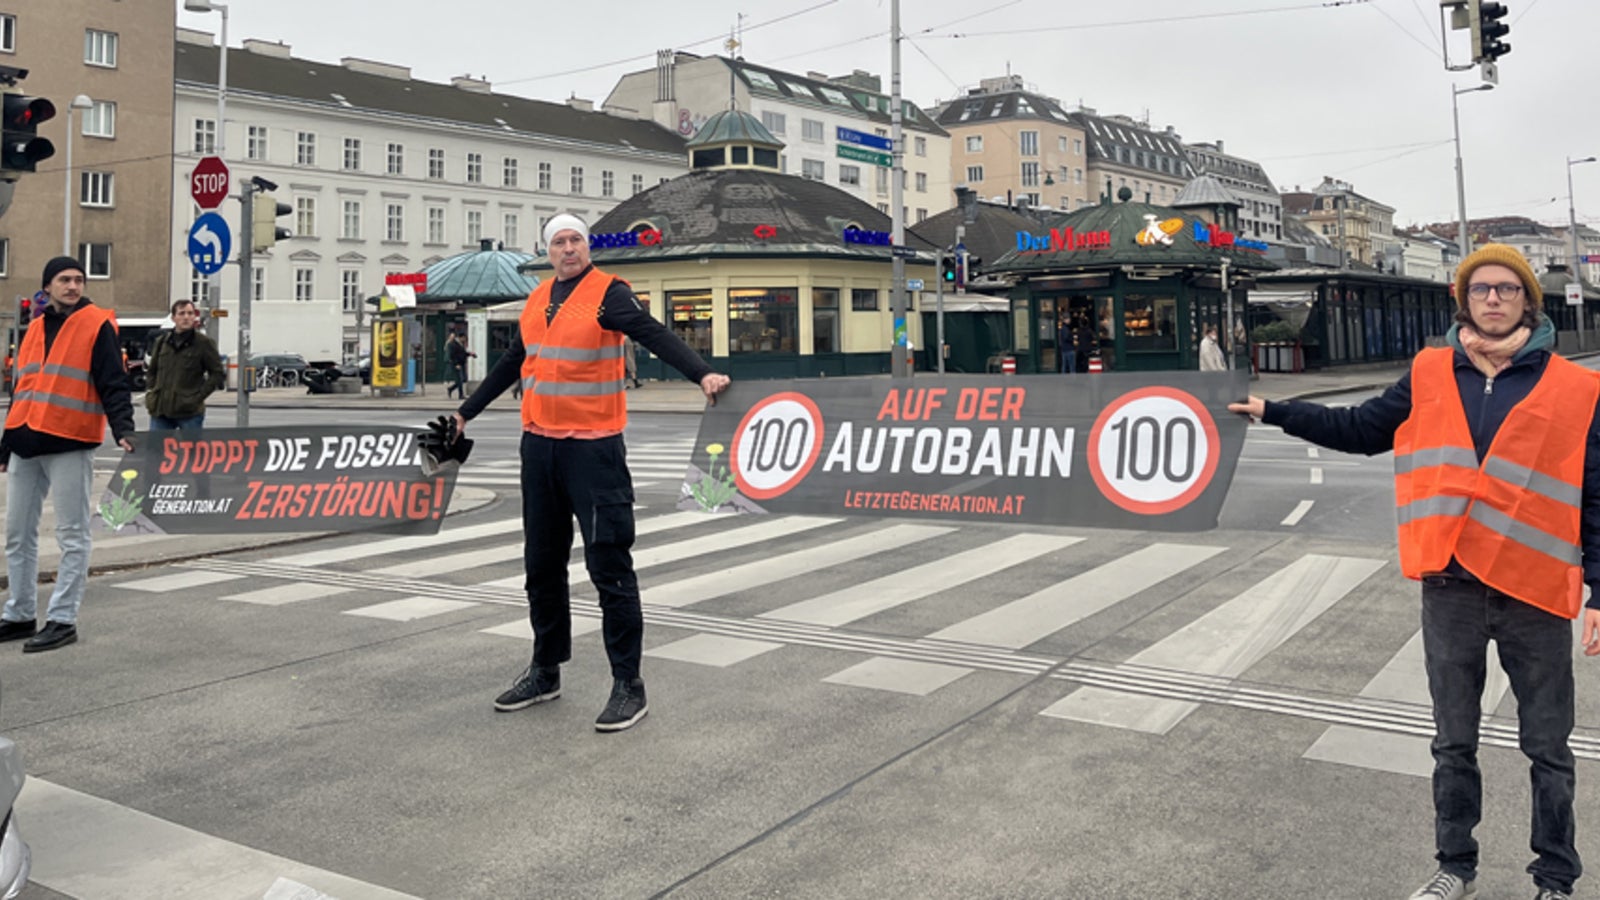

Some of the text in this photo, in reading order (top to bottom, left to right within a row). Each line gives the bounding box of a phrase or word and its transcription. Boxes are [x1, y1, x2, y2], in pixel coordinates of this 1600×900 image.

[194, 173, 227, 194] STOP
[589, 231, 639, 250] ORDSEE
[877, 387, 1026, 421] AUF DER
[159, 437, 259, 475] STOPPT
[263, 437, 312, 472] DIE
[747, 417, 809, 472] 100
[822, 421, 1076, 478] AUTOBAHN
[1111, 416, 1197, 483] 100
[149, 483, 189, 499] LETZTE
[152, 498, 233, 514] GENERATION.AT
[235, 475, 445, 521] ZERSTÖRUNG!
